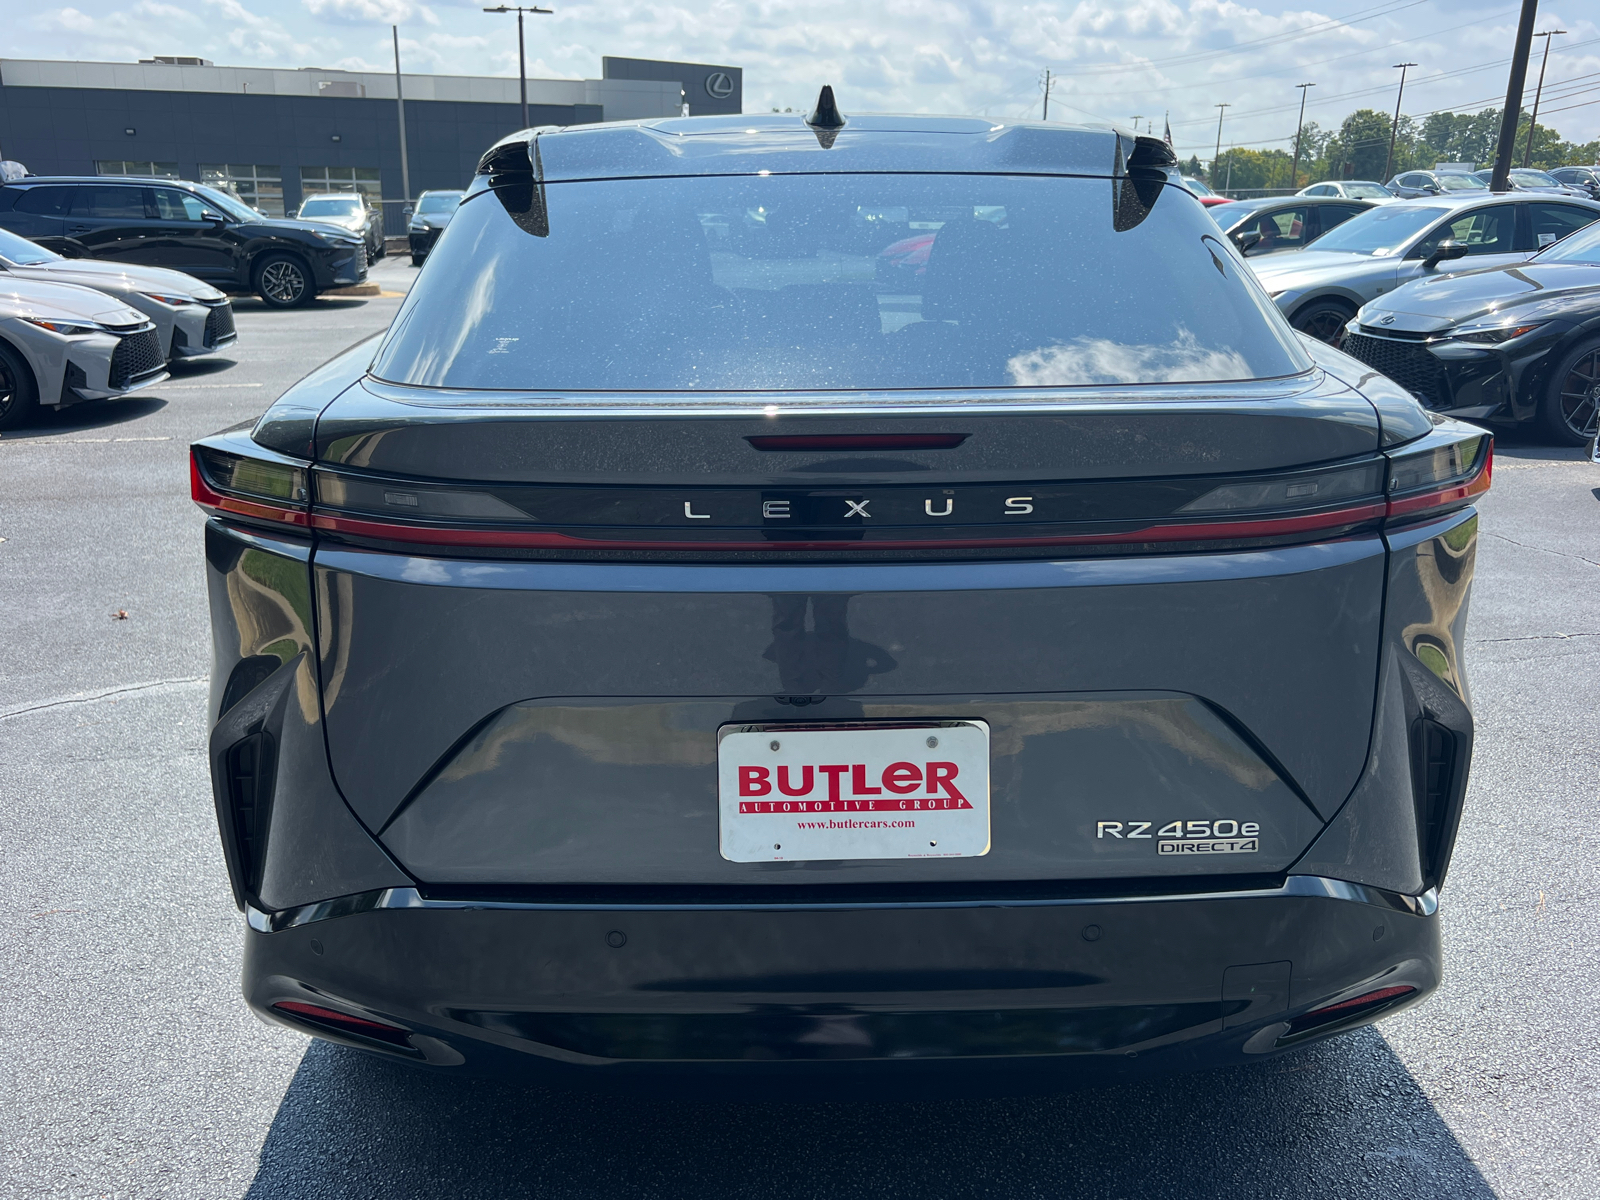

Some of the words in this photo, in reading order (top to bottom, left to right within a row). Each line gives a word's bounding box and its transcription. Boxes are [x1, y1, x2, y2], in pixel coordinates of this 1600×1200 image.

[684, 496, 1034, 519] LEXUS
[740, 801, 875, 812] AUTOMOTIVE
[899, 798, 964, 810] GROUP
[797, 818, 915, 830] www.butlercars.com
[1160, 840, 1257, 853] DIRECT4
